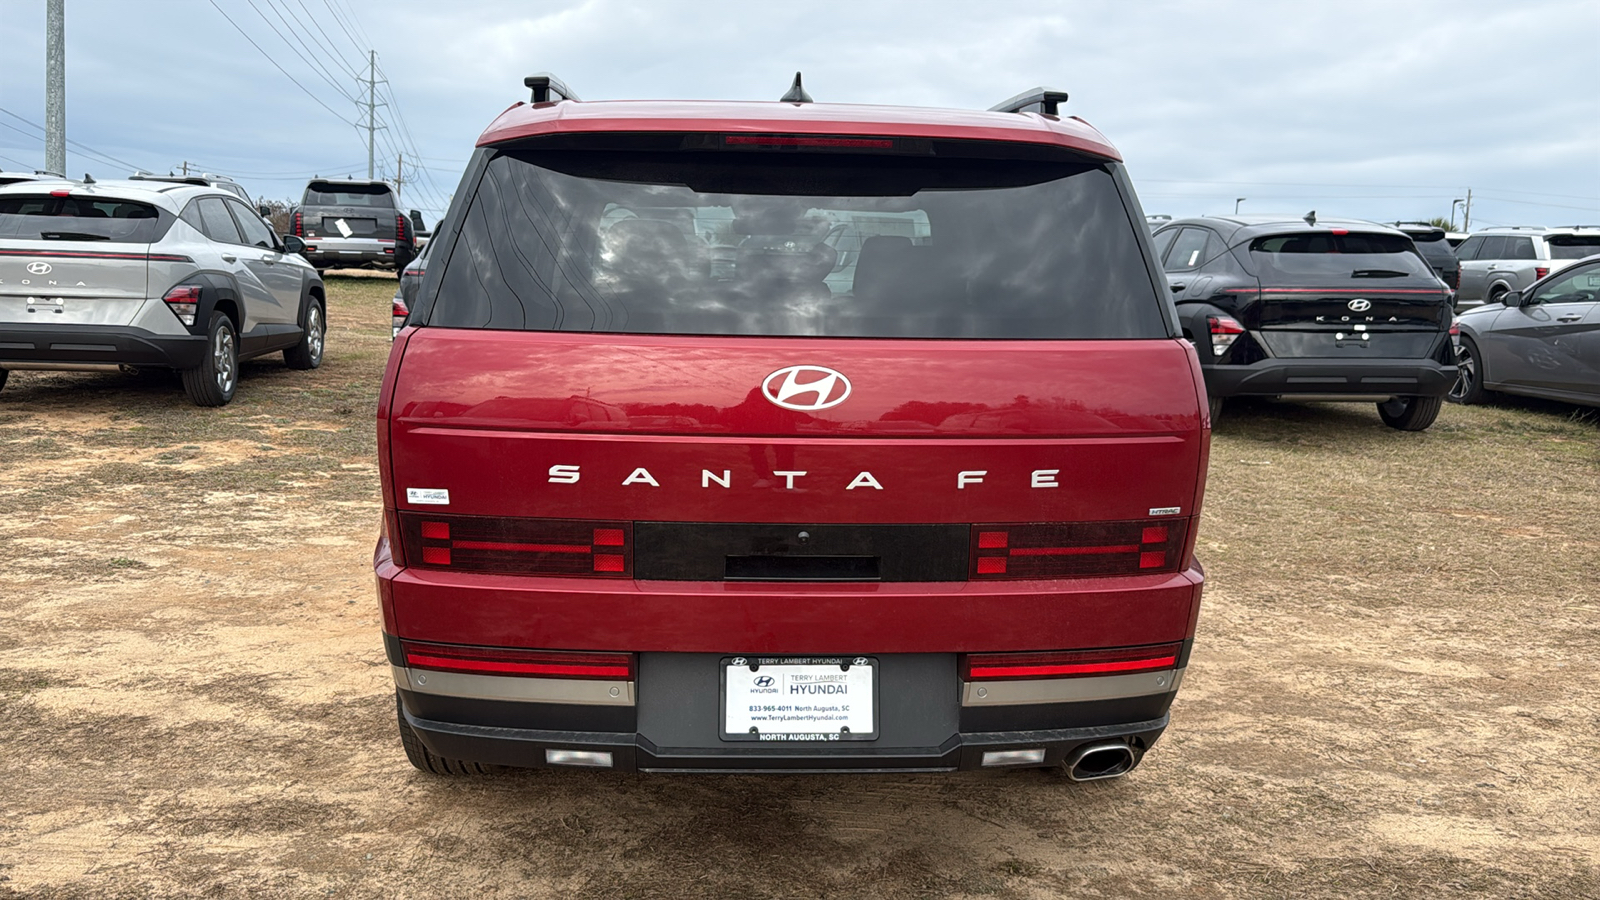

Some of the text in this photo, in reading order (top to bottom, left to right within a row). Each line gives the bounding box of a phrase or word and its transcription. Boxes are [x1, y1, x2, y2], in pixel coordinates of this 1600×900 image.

[548, 464, 1061, 491] SANTA FE
[790, 685, 848, 695] HYUNDAI
[813, 705, 840, 713] Augusta,
[751, 714, 849, 722] www.TerryLambertHyundai.com
